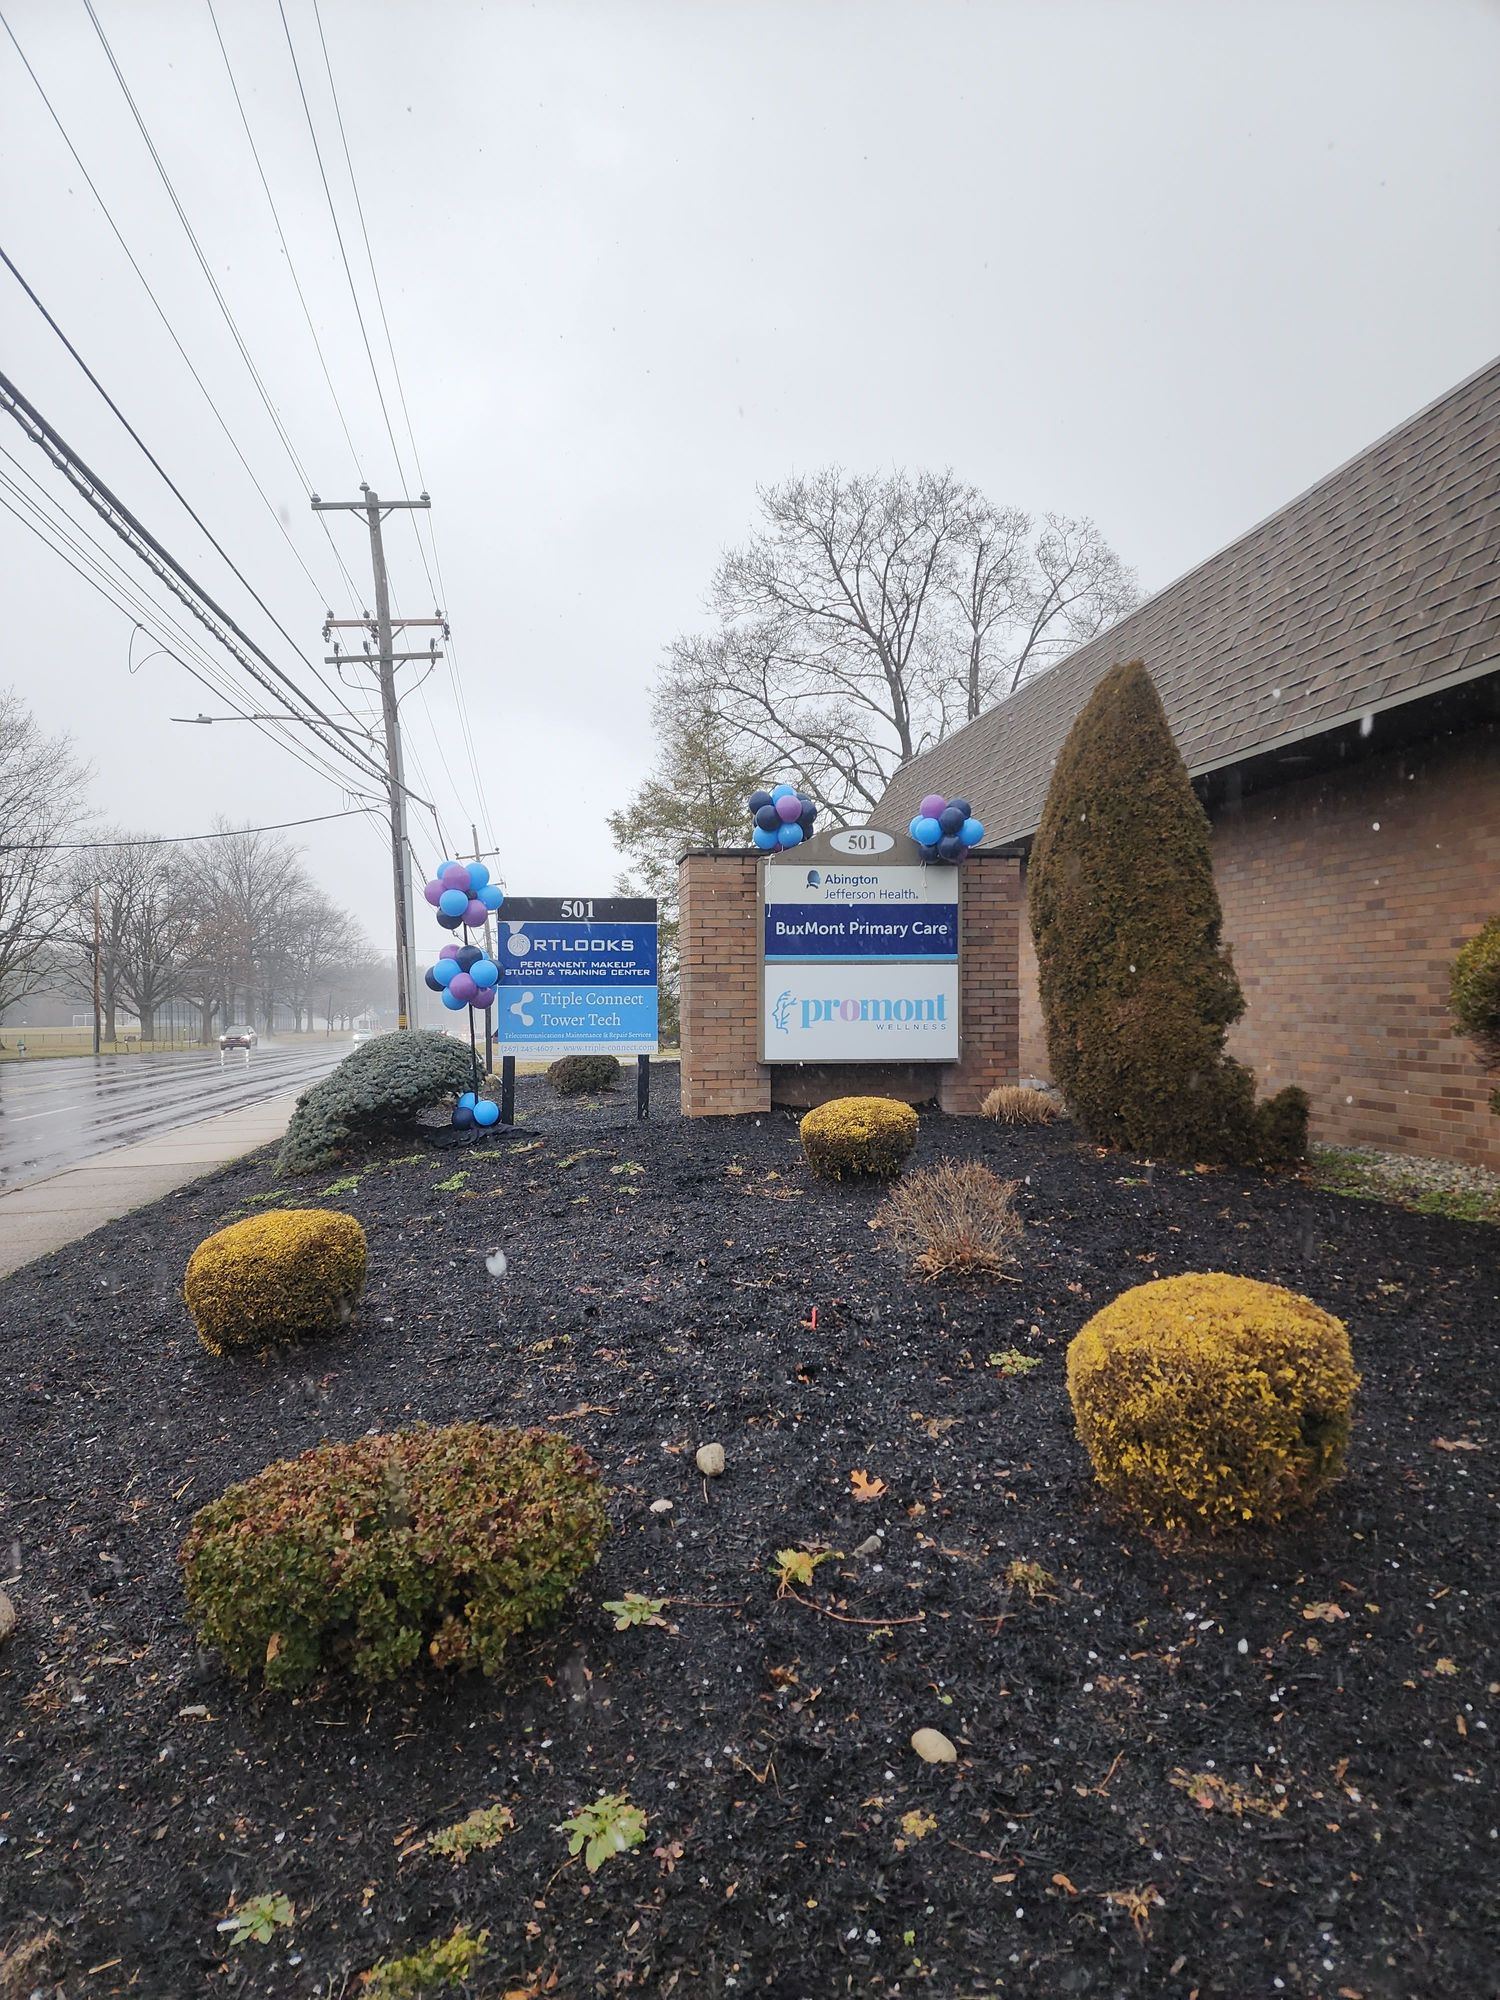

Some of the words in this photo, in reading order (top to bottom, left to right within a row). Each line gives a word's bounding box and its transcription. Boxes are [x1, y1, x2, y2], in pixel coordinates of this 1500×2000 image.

[847, 834, 876, 850] 501
[825, 873, 879, 887] Abington
[824, 888, 876, 900] Jefferson
[560, 900, 595, 918] 501
[775, 921, 845, 936] BuxMont
[849, 921, 908, 938] Primary
[912, 921, 948, 935] Care
[520, 961, 587, 969] PERMANENT
[591, 961, 636, 969] MAKEUP
[504, 969, 543, 977] STUDIO
[558, 969, 607, 977] TRAINING
[610, 969, 651, 977] CENTER
[540, 991, 582, 1009] Triple
[585, 992, 644, 1006] Connect
[800, 993, 948, 1029] promont
[540, 1013, 584, 1027] Tower
[587, 1012, 622, 1027] Tech
[876, 1023, 948, 1031] WELLNESS
